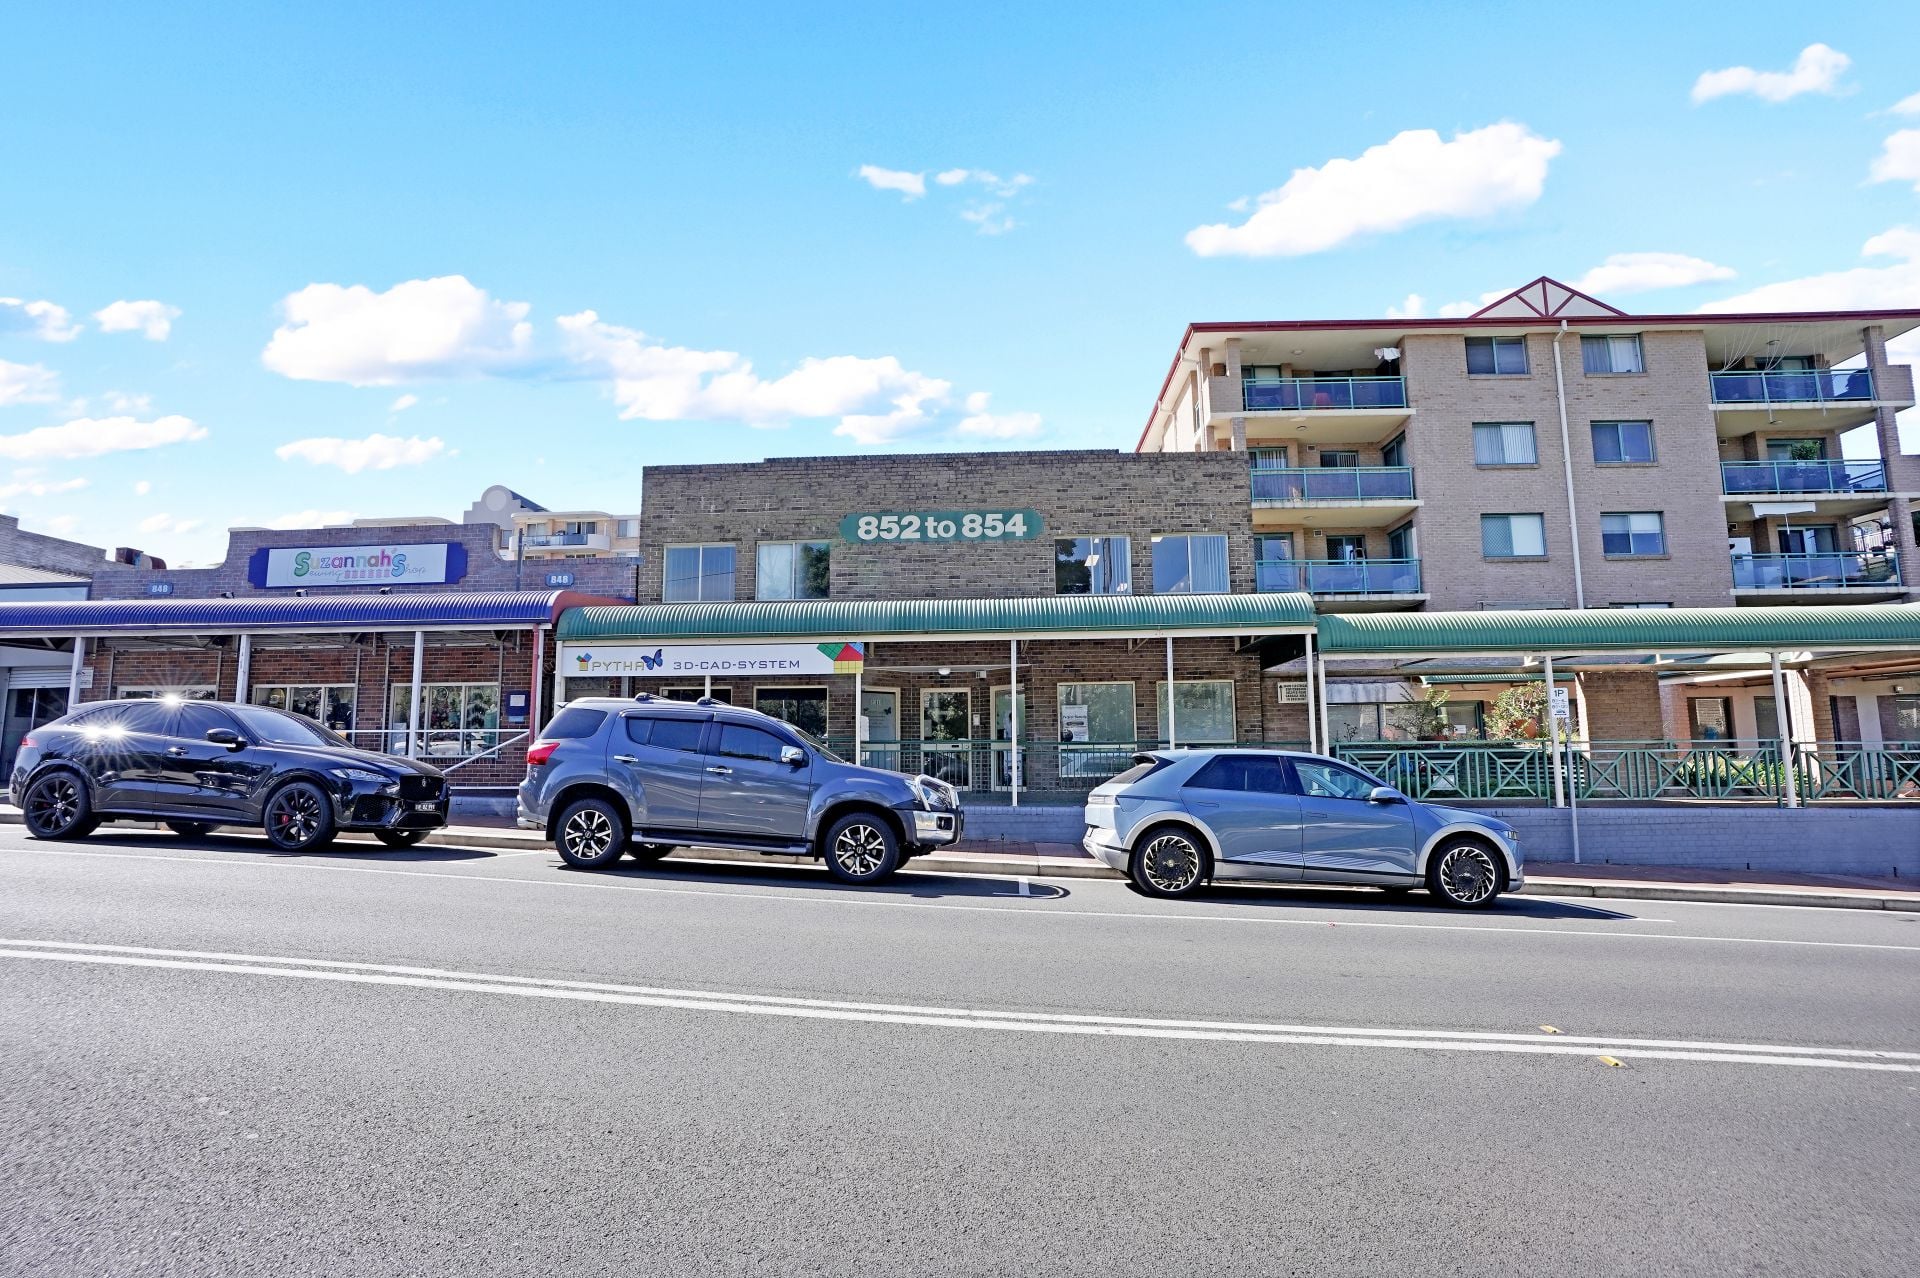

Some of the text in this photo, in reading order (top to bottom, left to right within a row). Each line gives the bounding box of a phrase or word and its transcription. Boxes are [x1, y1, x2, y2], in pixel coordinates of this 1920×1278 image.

[857, 513, 1027, 540] 852 to 854
[551, 575, 568, 583] 848
[591, 659, 800, 672] PYTHA 3D-CAD-SYSTEM
[1554, 689, 1564, 697] 1P
